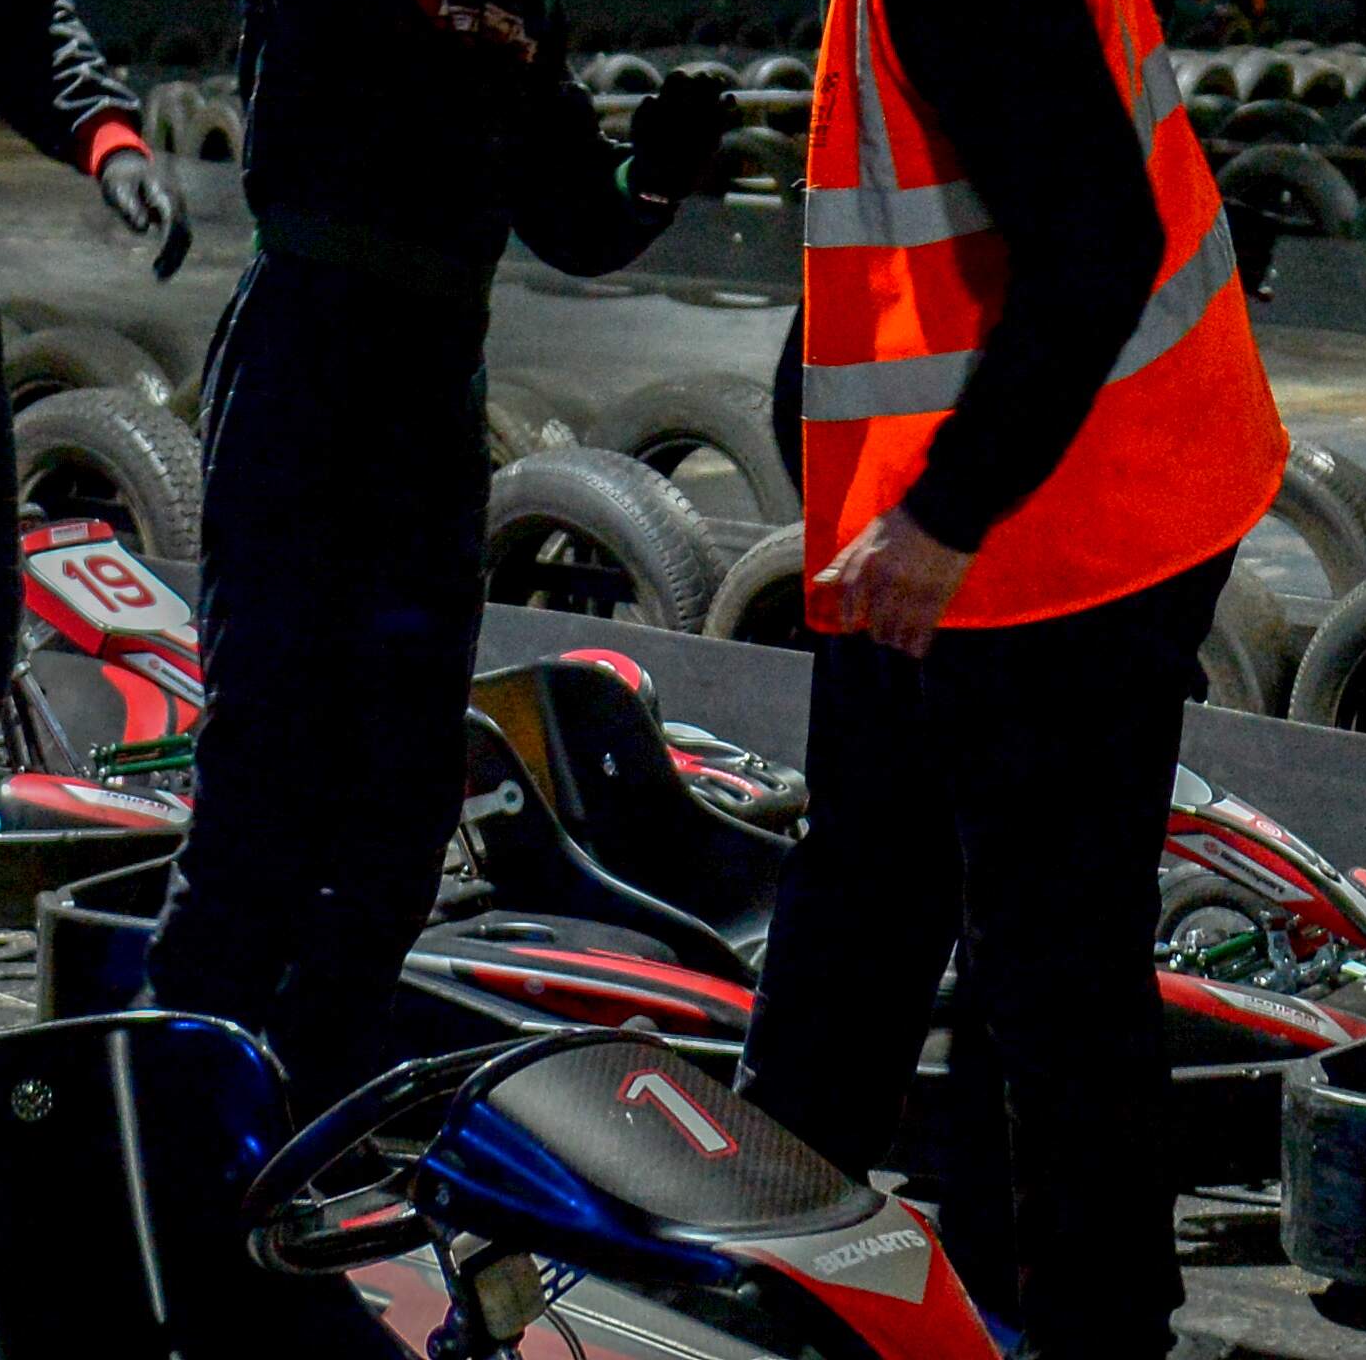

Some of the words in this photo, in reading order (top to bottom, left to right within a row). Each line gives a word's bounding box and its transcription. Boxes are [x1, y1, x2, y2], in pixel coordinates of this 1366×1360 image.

[62, 554, 158, 613] 19
[620, 1069, 738, 1158] 1
[812, 1228, 927, 1276] BIZKARTS
